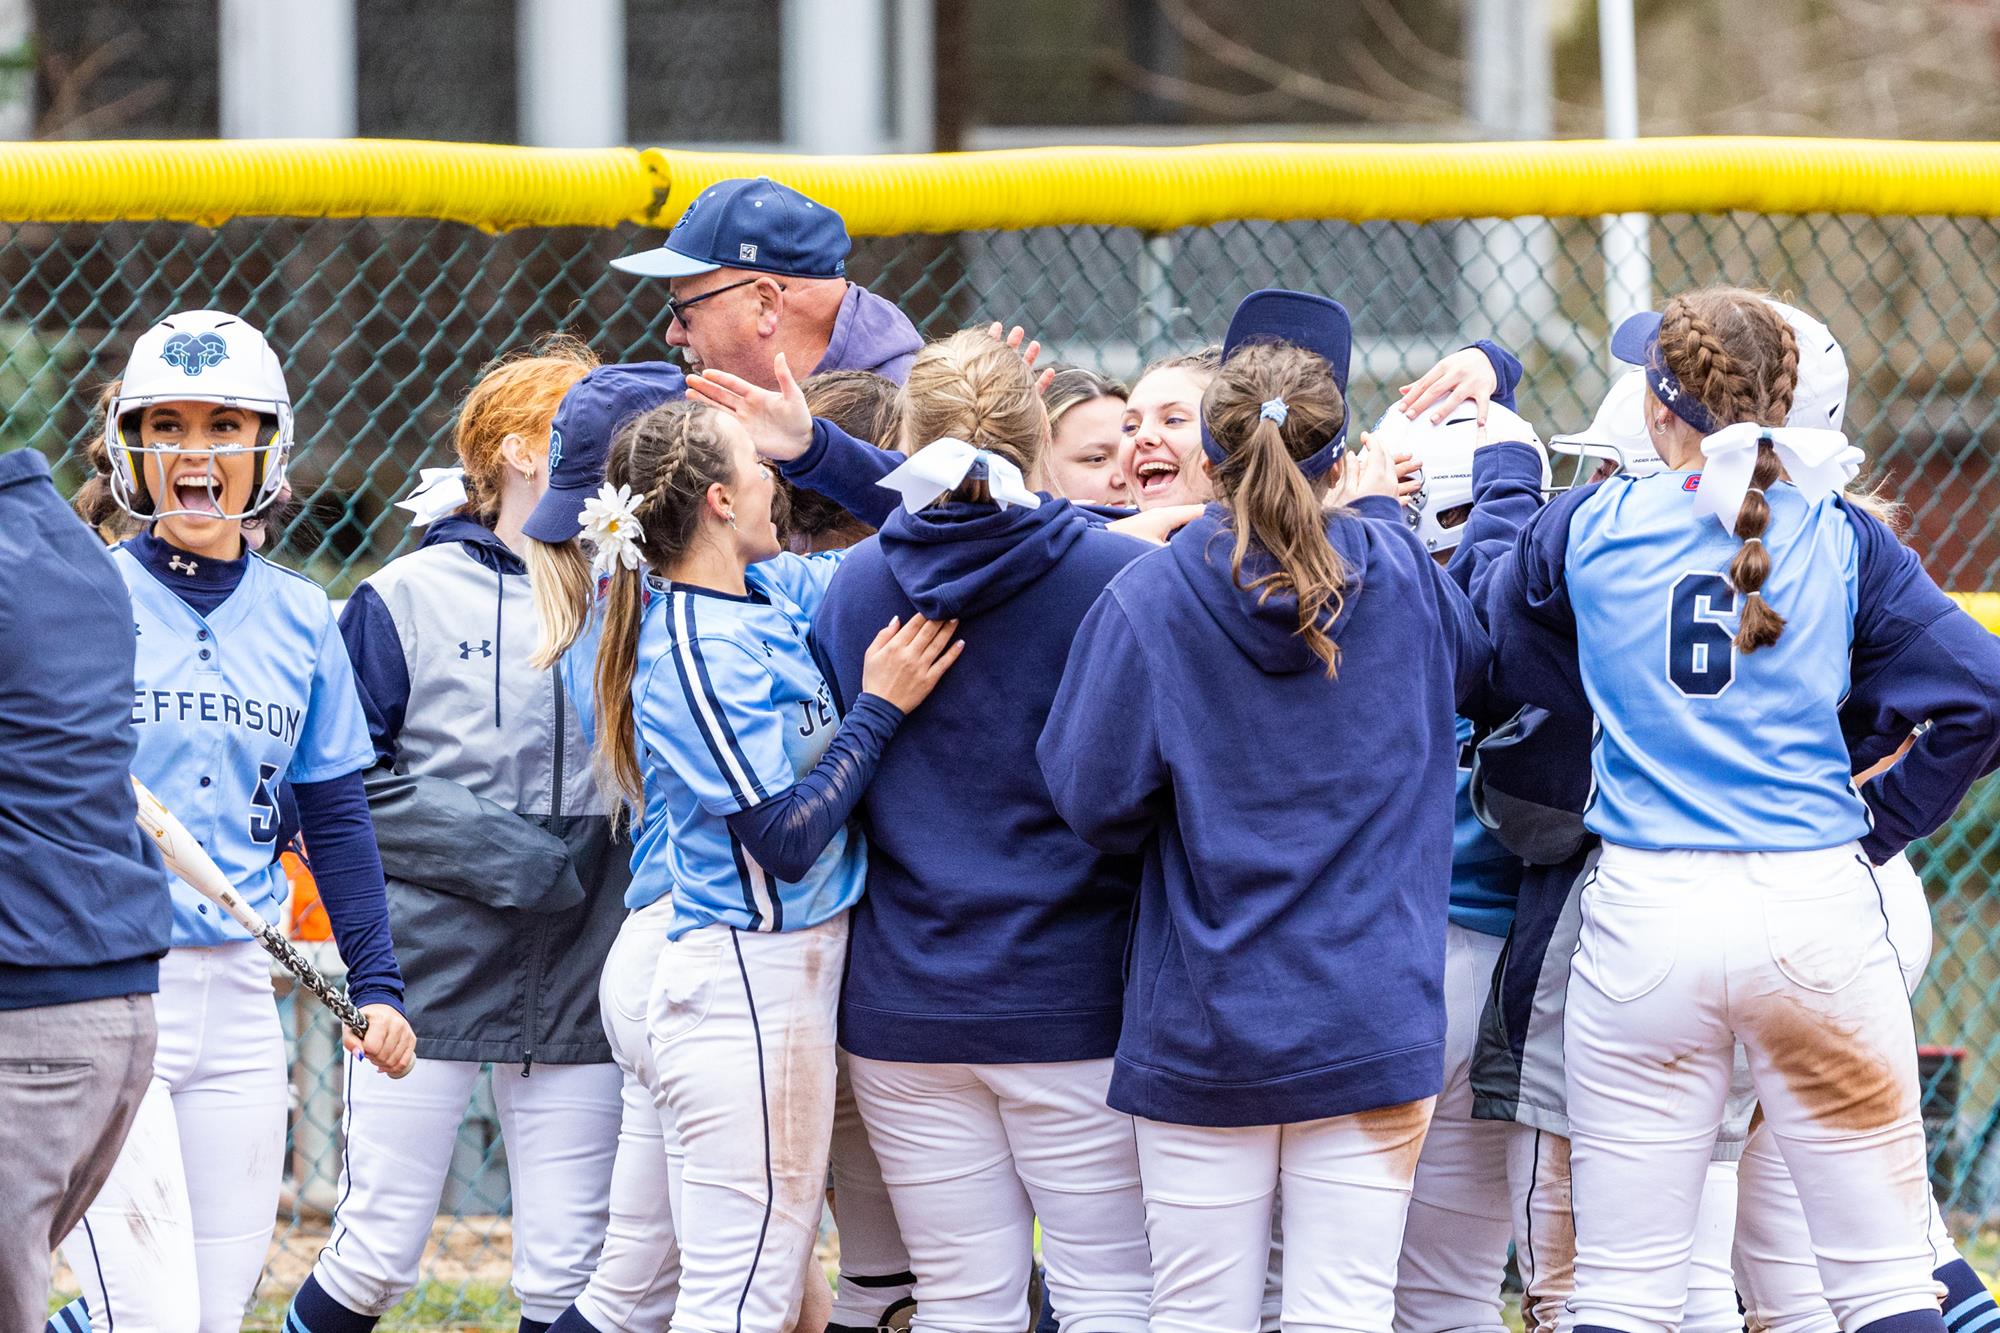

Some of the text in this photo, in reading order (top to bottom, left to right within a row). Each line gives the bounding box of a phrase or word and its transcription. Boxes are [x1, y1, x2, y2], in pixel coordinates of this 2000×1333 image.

[1682, 474, 1702, 492] C
[1666, 569, 1737, 699] 6
[131, 688, 301, 748] EFFERSON
[248, 761, 281, 844] 5
